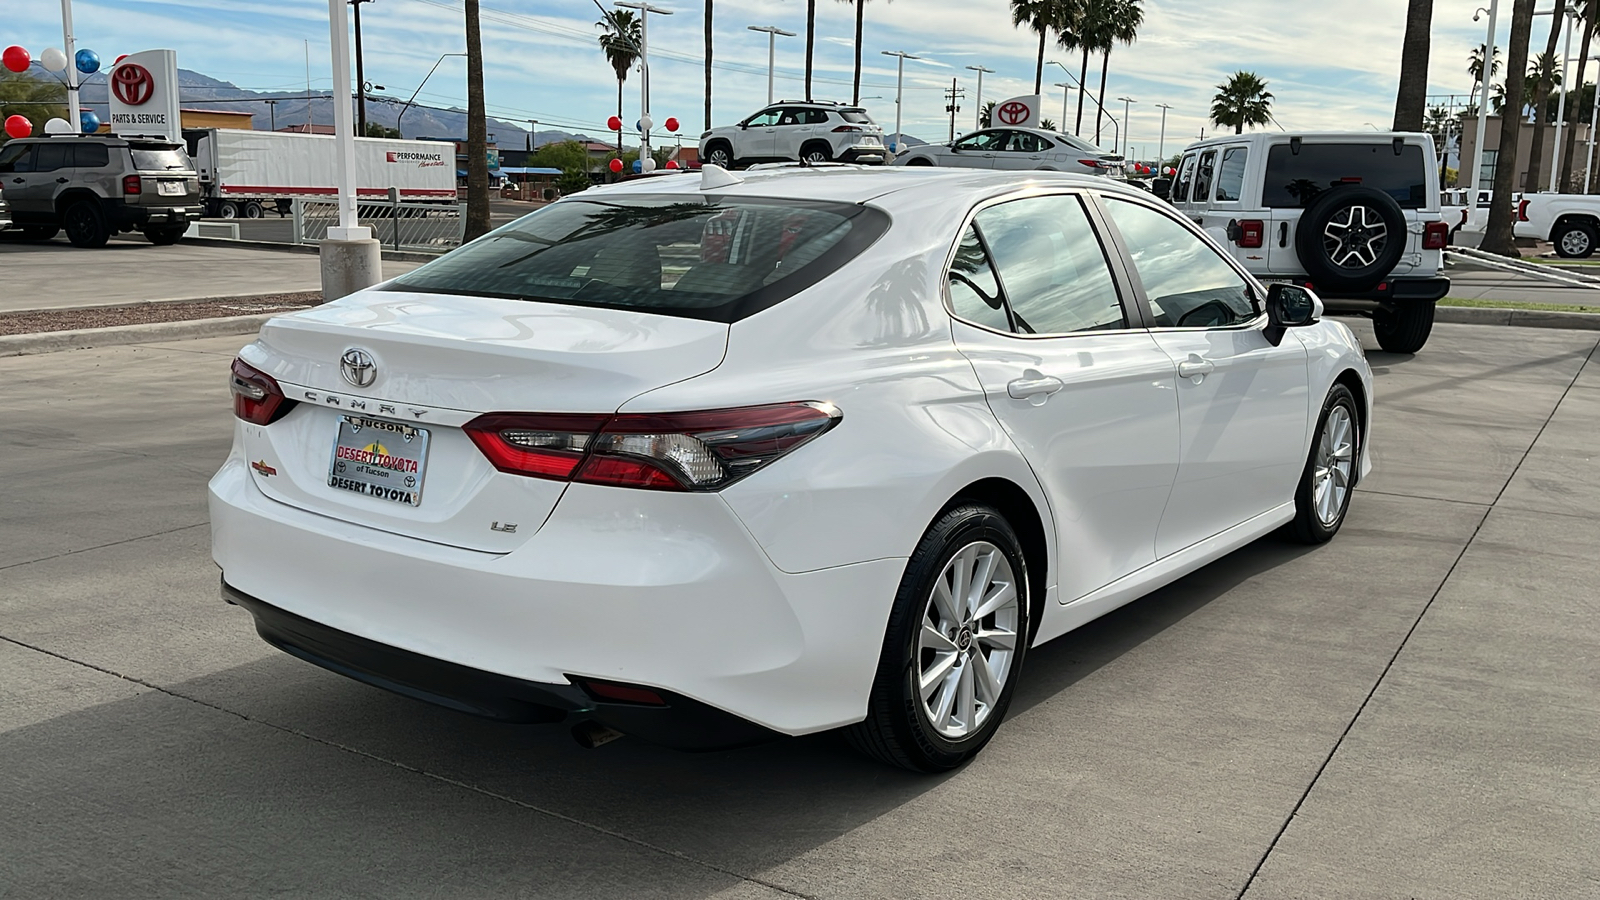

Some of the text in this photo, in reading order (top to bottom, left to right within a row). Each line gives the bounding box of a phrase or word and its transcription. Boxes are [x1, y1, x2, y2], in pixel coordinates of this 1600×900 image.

[112, 113, 166, 124] PARTS & SERVICE
[397, 152, 441, 160] PERFORMANCE
[304, 391, 428, 418] CAMRY
[360, 419, 404, 433] TUCSON
[337, 446, 418, 473] DESERT TOYOTA
[365, 466, 390, 478] Tucson
[331, 476, 412, 504] DESERT TOYOTA
[490, 521, 518, 533] LE
